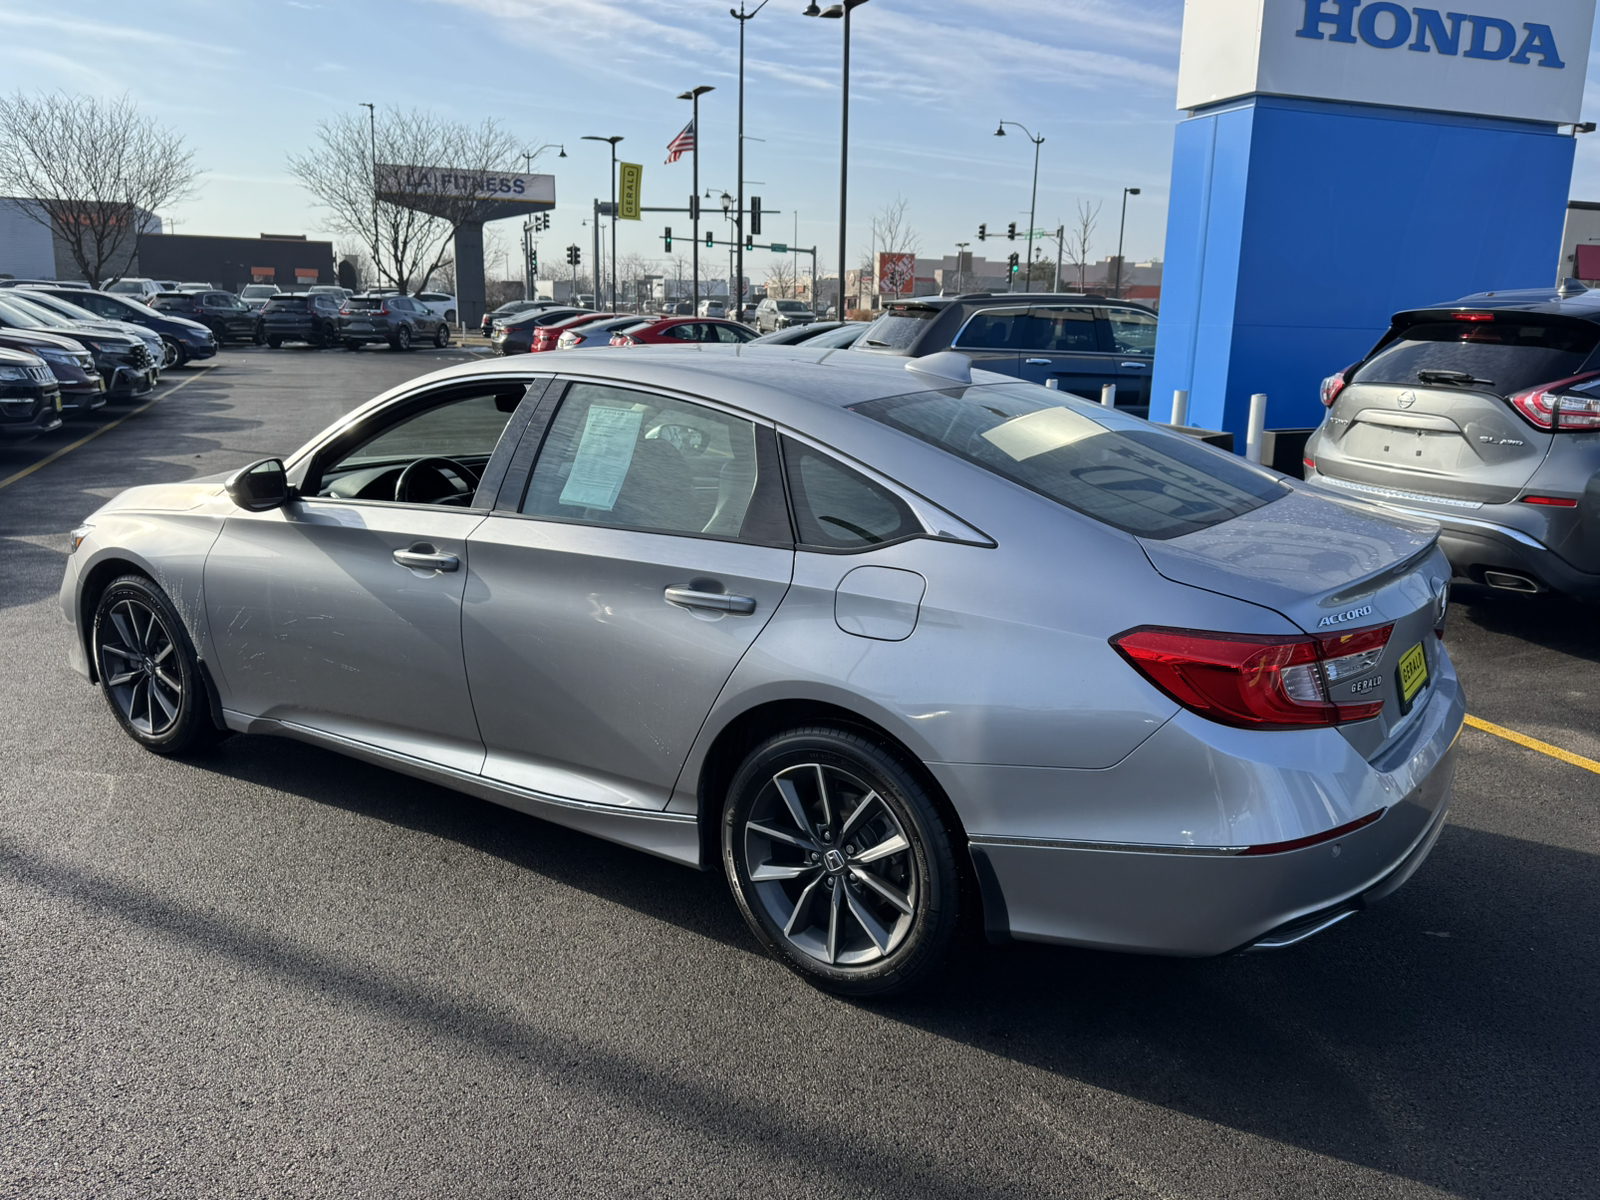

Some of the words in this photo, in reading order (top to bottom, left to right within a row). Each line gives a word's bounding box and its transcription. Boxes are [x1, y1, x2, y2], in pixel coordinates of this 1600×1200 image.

[1295, 0, 1566, 69] HONDA
[406, 172, 432, 188] LA
[441, 173, 526, 194] FITNESS
[626, 170, 635, 213] GERALD
[1317, 605, 1372, 628] ACCORD
[1403, 652, 1423, 683] GERALD
[1351, 676, 1382, 693] GERALD
